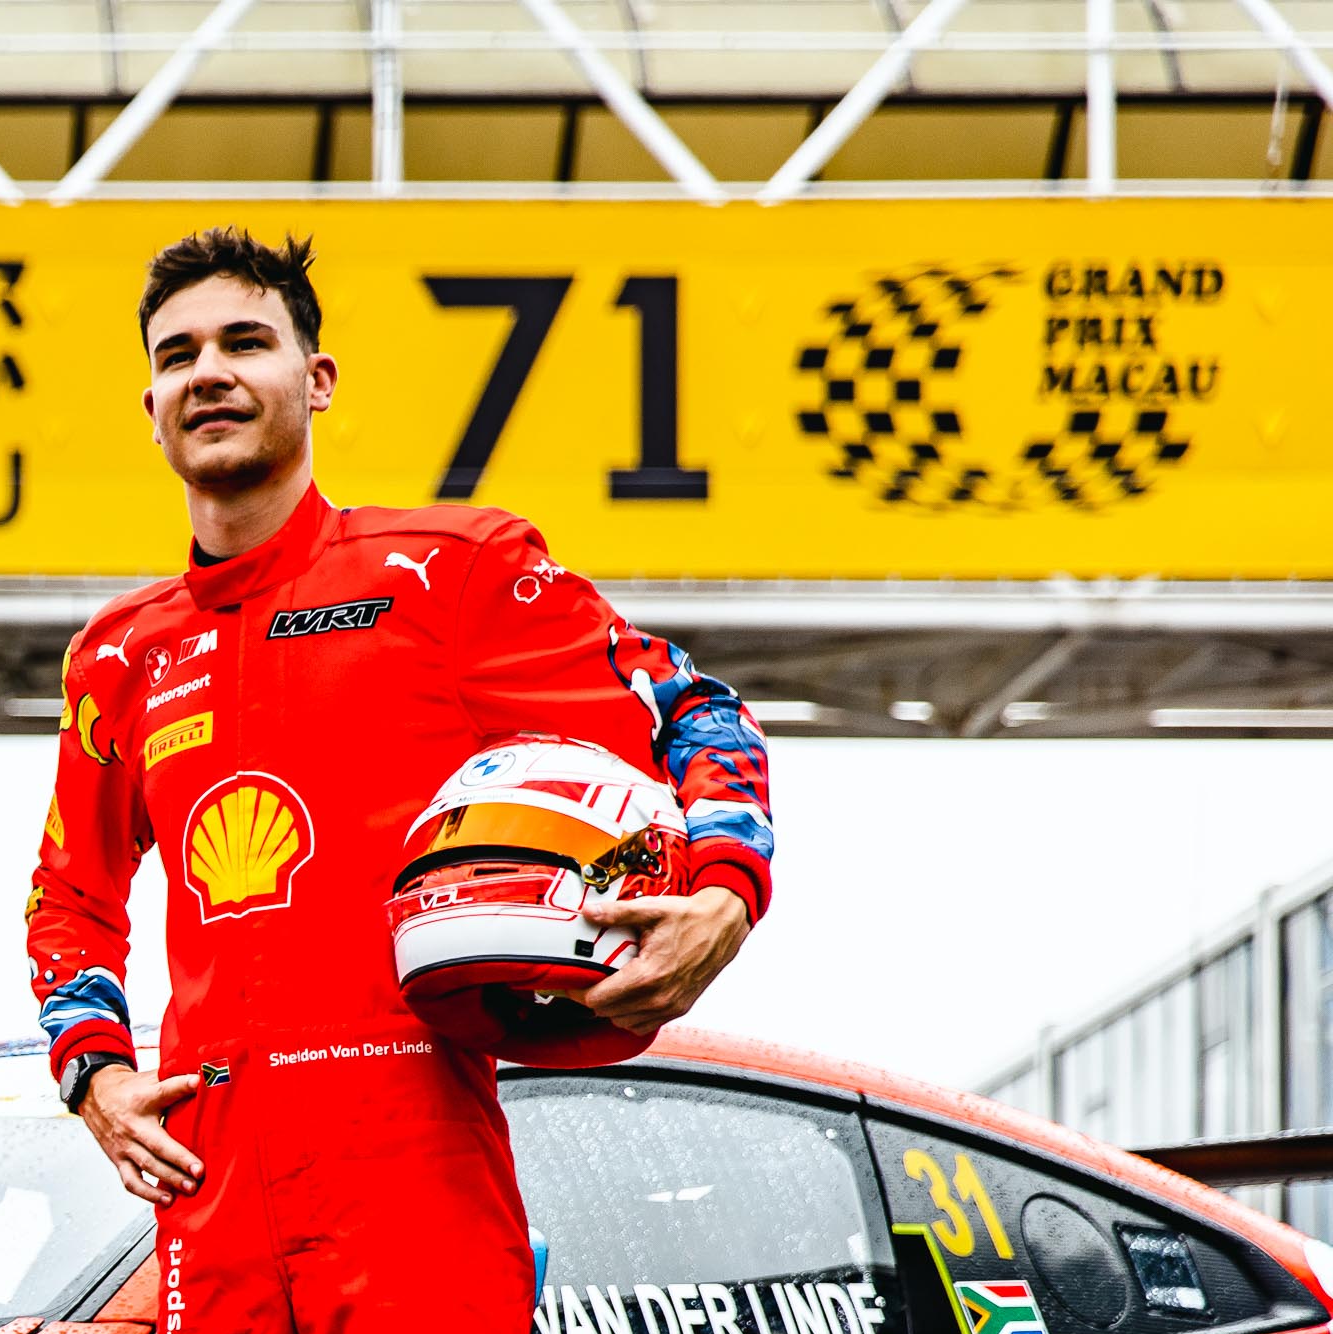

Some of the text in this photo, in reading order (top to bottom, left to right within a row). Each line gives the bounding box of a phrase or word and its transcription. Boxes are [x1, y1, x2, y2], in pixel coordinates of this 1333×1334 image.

[1042, 262, 1225, 304] GRAND
[1042, 314, 1158, 350] PRIX
[417, 273, 711, 503] 71
[1039, 360, 1219, 401] MACAU
[269, 599, 391, 638] WRT
[146, 673, 211, 713] Motorsport
[149, 720, 205, 761] PIRELLI
[269, 1041, 432, 1067] Sheldon Van Der Linde
[903, 1148, 1015, 1260] 31
